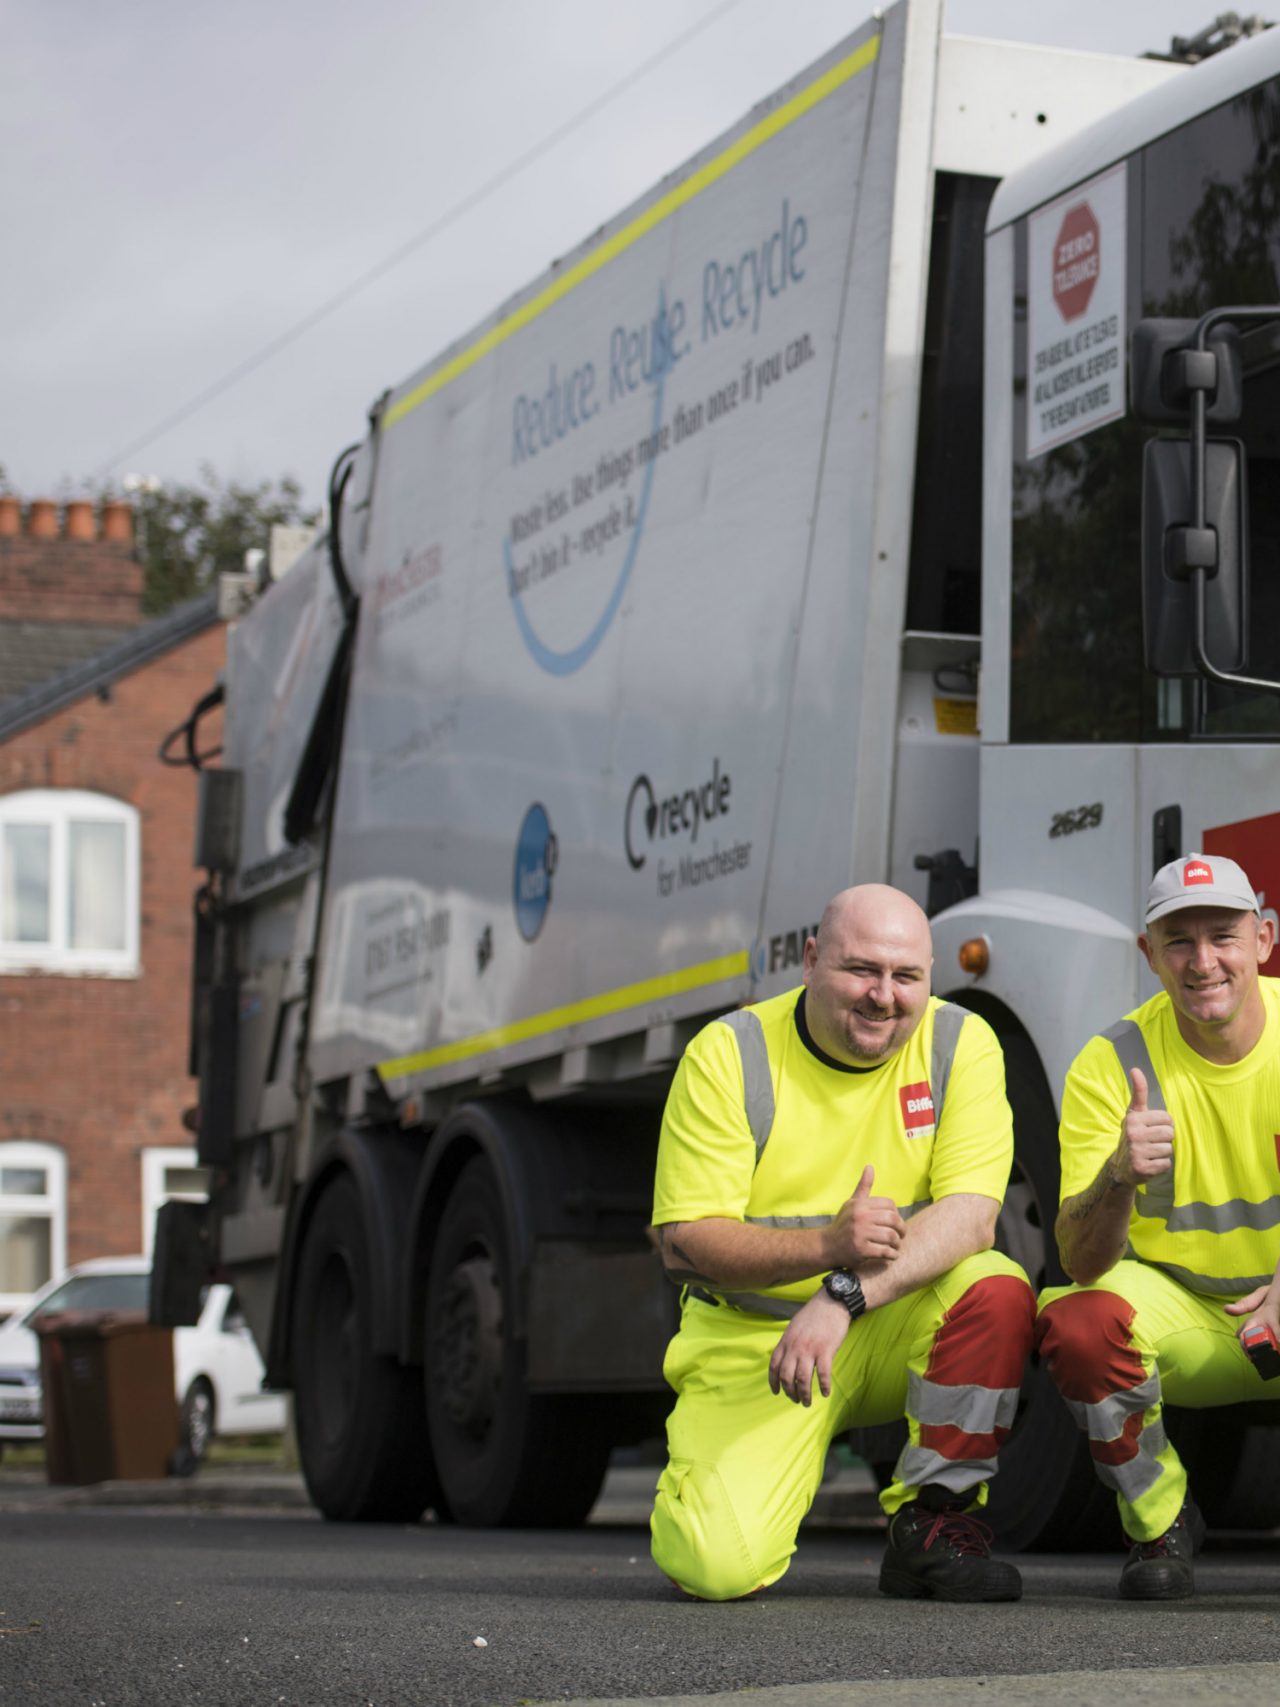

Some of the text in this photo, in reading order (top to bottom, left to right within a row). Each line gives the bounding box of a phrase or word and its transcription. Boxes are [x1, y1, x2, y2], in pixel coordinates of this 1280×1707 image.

[701, 197, 808, 342] Recycle
[673, 404, 704, 444] than
[707, 380, 739, 423] once
[756, 352, 782, 403] you
[659, 757, 731, 844] recycle
[678, 838, 752, 891] Manchester
